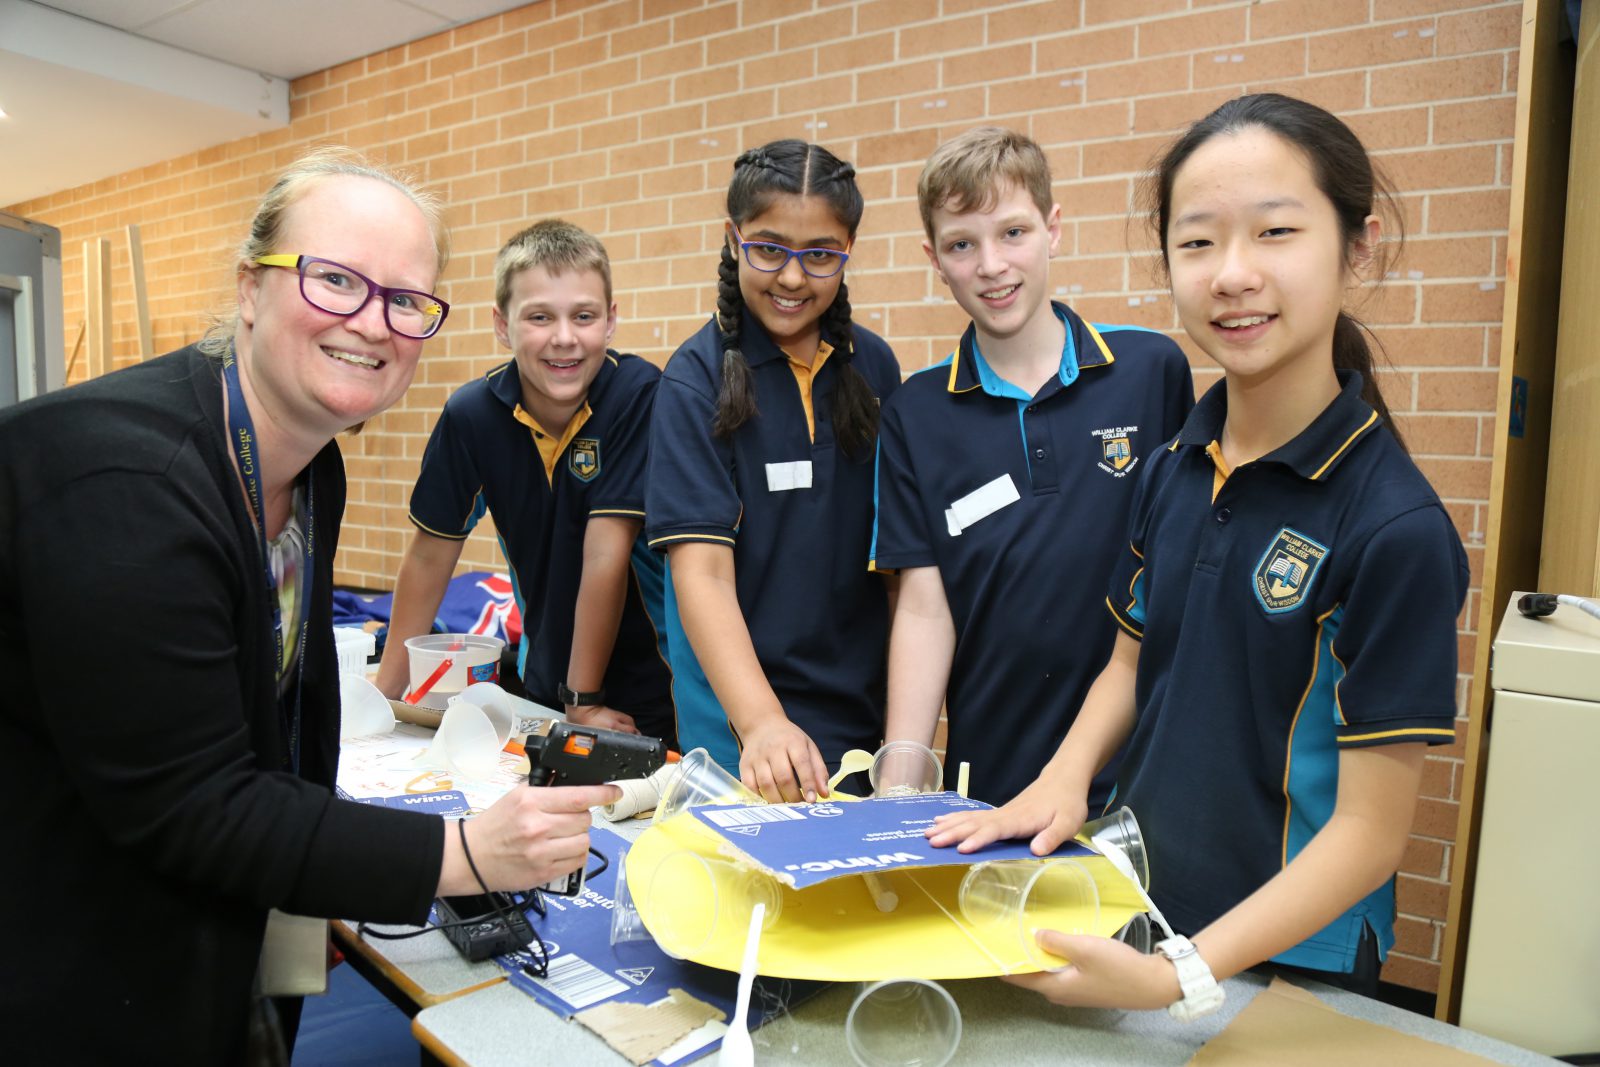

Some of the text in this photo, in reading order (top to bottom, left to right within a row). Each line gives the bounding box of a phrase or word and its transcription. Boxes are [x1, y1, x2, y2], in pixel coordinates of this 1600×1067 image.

[1091, 428, 1115, 436] WILLIAM
[1102, 432, 1127, 440] COLLEGE
[238, 427, 254, 475] College
[1281, 533, 1323, 558] WILLIAM CLARKE
[1285, 544, 1310, 559] COLLEGE
[1257, 576, 1270, 597] CHRIST
[785, 852, 924, 873] winc.
